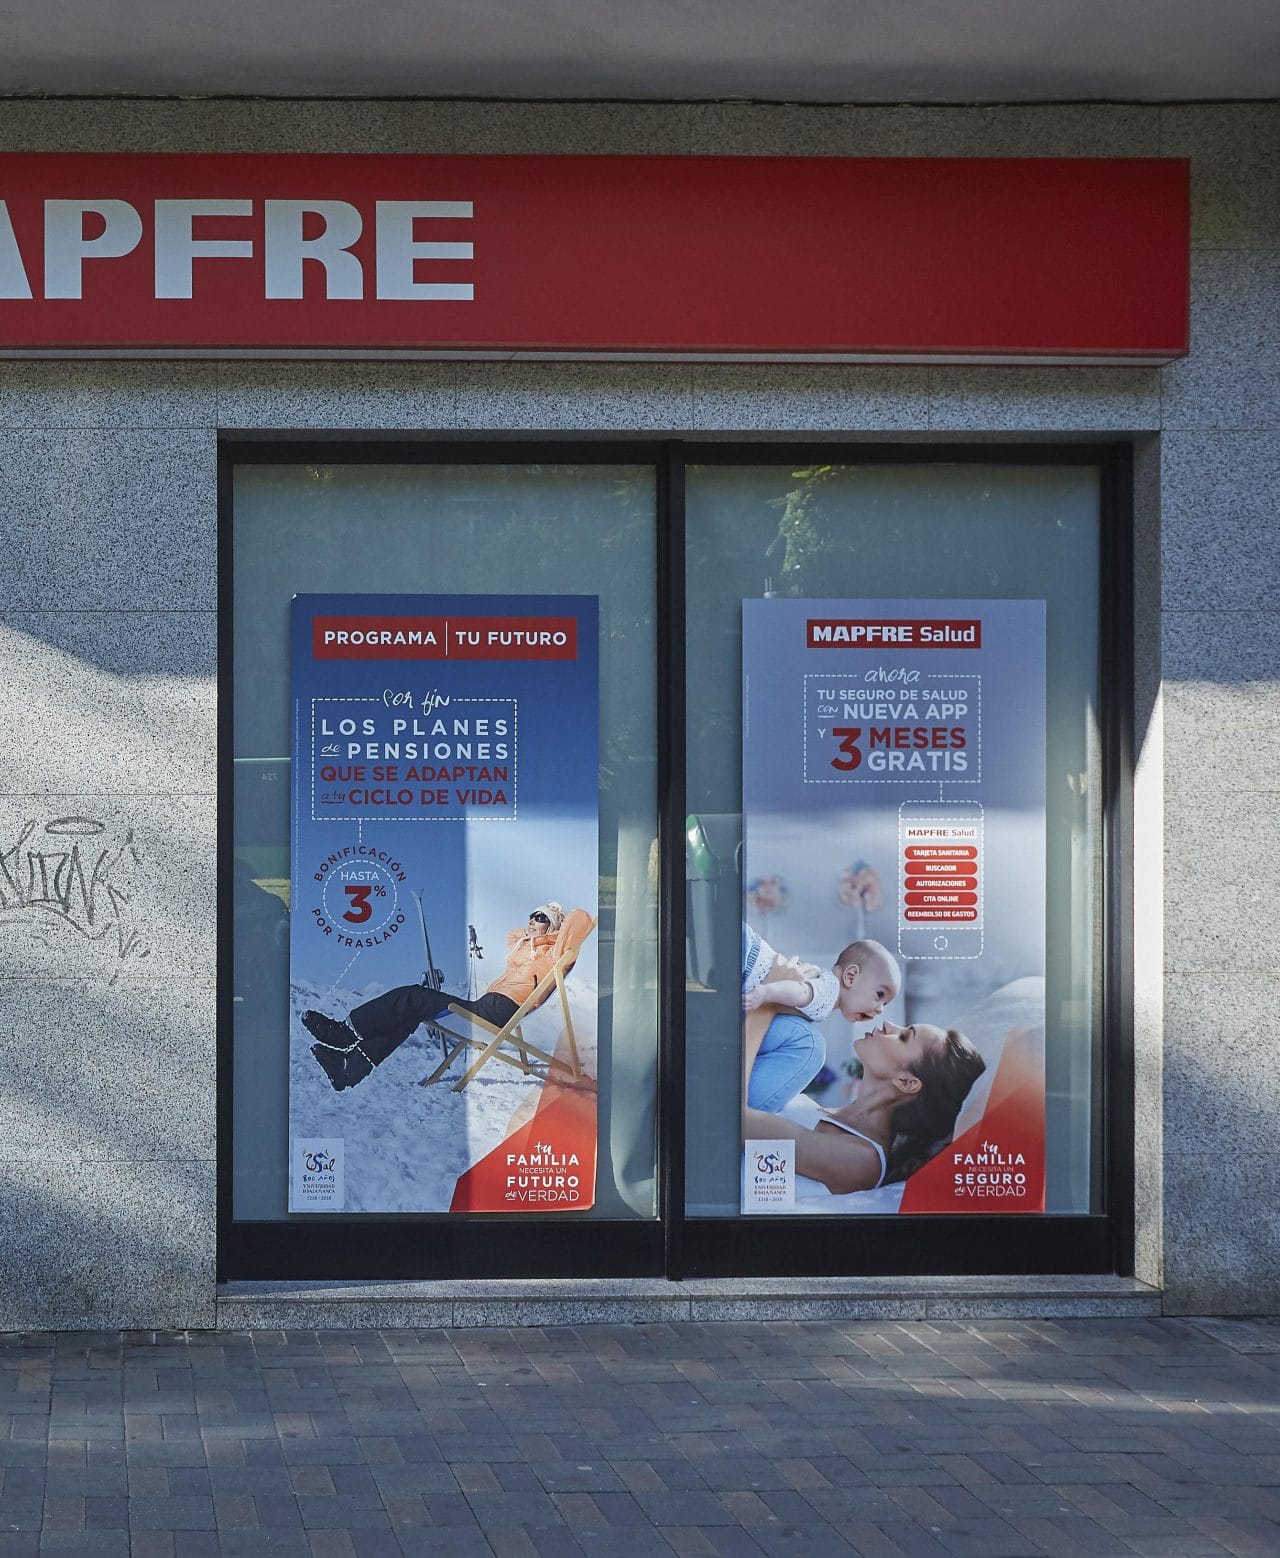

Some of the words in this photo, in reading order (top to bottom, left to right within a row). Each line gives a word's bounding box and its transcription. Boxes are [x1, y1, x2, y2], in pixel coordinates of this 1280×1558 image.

[324, 631, 437, 645] PROGRAMA
[455, 631, 480, 645] TU
[488, 631, 567, 645] FUTURO
[813, 626, 912, 642] MAPFRE
[920, 625, 974, 642] Salud
[864, 666, 920, 684] ahora
[421, 688, 450, 716] fin
[817, 690, 835, 701] TU
[839, 689, 895, 701] SEGURO
[900, 690, 918, 701] DE
[922, 690, 968, 701] SALUD
[817, 705, 839, 716] con
[844, 704, 918, 720] NUEVA
[925, 704, 968, 720] APP
[322, 719, 376, 736] LOS
[393, 719, 508, 736] PLANES
[348, 743, 508, 760] PENSIONES
[817, 728, 826, 739] Y
[831, 727, 862, 772] 3
[869, 727, 967, 749] MESES
[868, 751, 968, 771] GRATIS
[320, 766, 365, 783] QUE
[373, 766, 398, 783] SE
[405, 766, 508, 783] ADAPTAN
[348, 789, 413, 805] CICLO
[421, 789, 449, 805] DE
[456, 789, 508, 805] VIDA
[908, 829, 949, 837] MAPFRE
[952, 829, 974, 837] Salud
[313, 846, 406, 882] BONIFICACIÓN
[340, 872, 380, 881] HASTA
[312, 908, 332, 936] POR
[534, 1141, 552, 1155] tu
[980, 1140, 998, 1155] tu
[507, 1154, 580, 1166] FAMILIA
[954, 1153, 1025, 1165] FAMILIA
[507, 1176, 579, 1188] FUTURO
[954, 1173, 1026, 1185] SEGURO
[517, 1190, 580, 1202] VERDAD
[967, 1185, 1026, 1197] VERDAD
